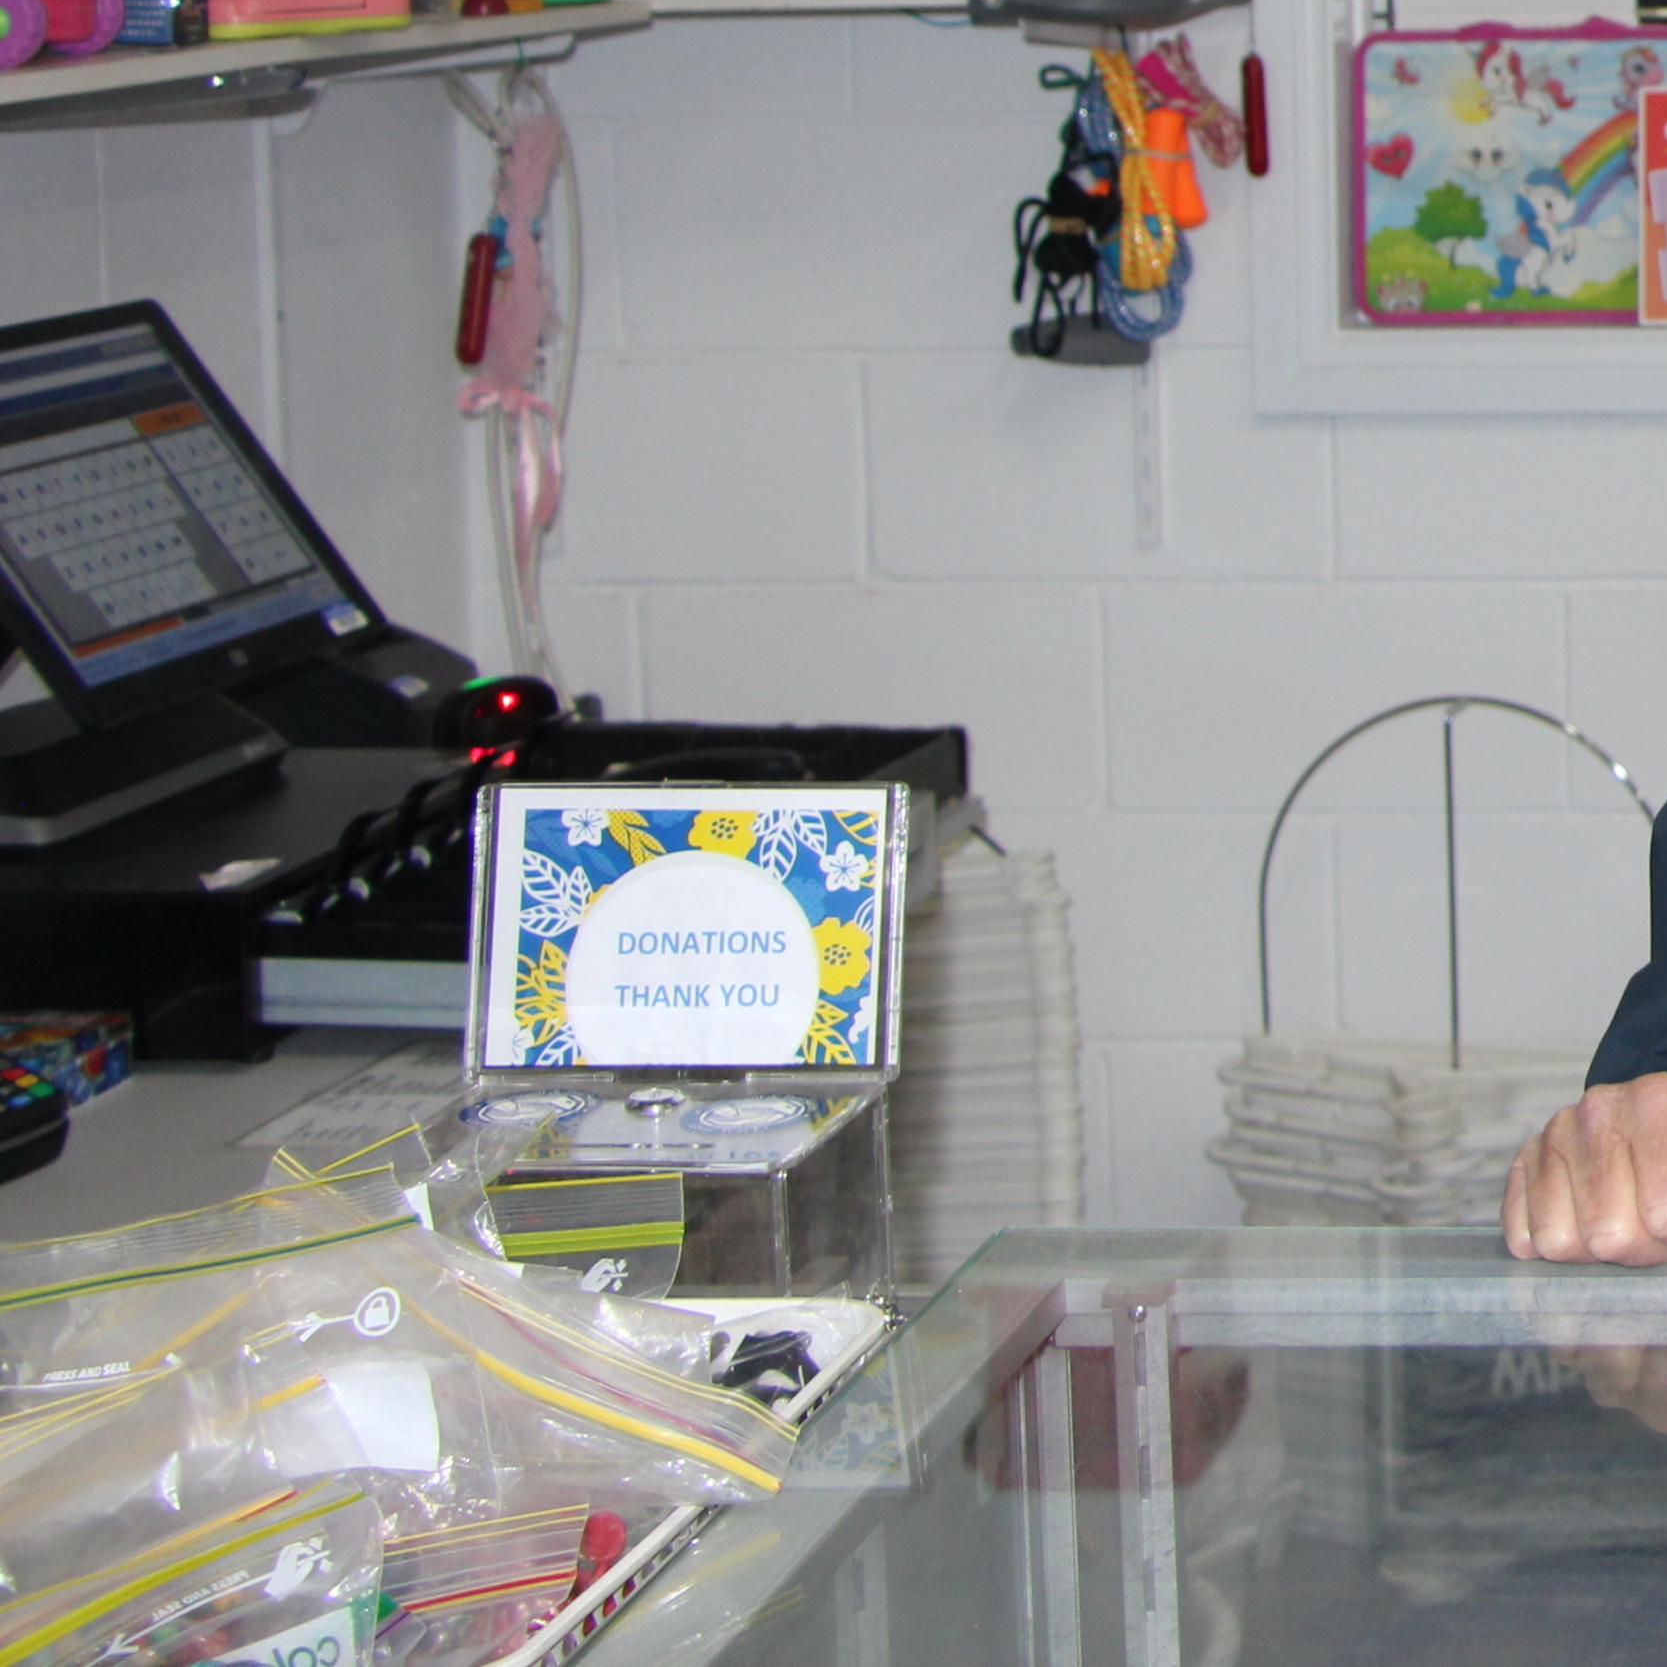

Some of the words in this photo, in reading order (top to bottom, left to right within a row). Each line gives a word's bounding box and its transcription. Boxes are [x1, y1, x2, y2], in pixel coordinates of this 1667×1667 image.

[617, 931, 787, 956] DONATIONS
[614, 983, 710, 1009] THANK
[719, 983, 780, 1007] YOU
[42, 1369, 77, 1383] PRESS
[78, 1364, 102, 1379] AND
[103, 1361, 131, 1376] SEAL
